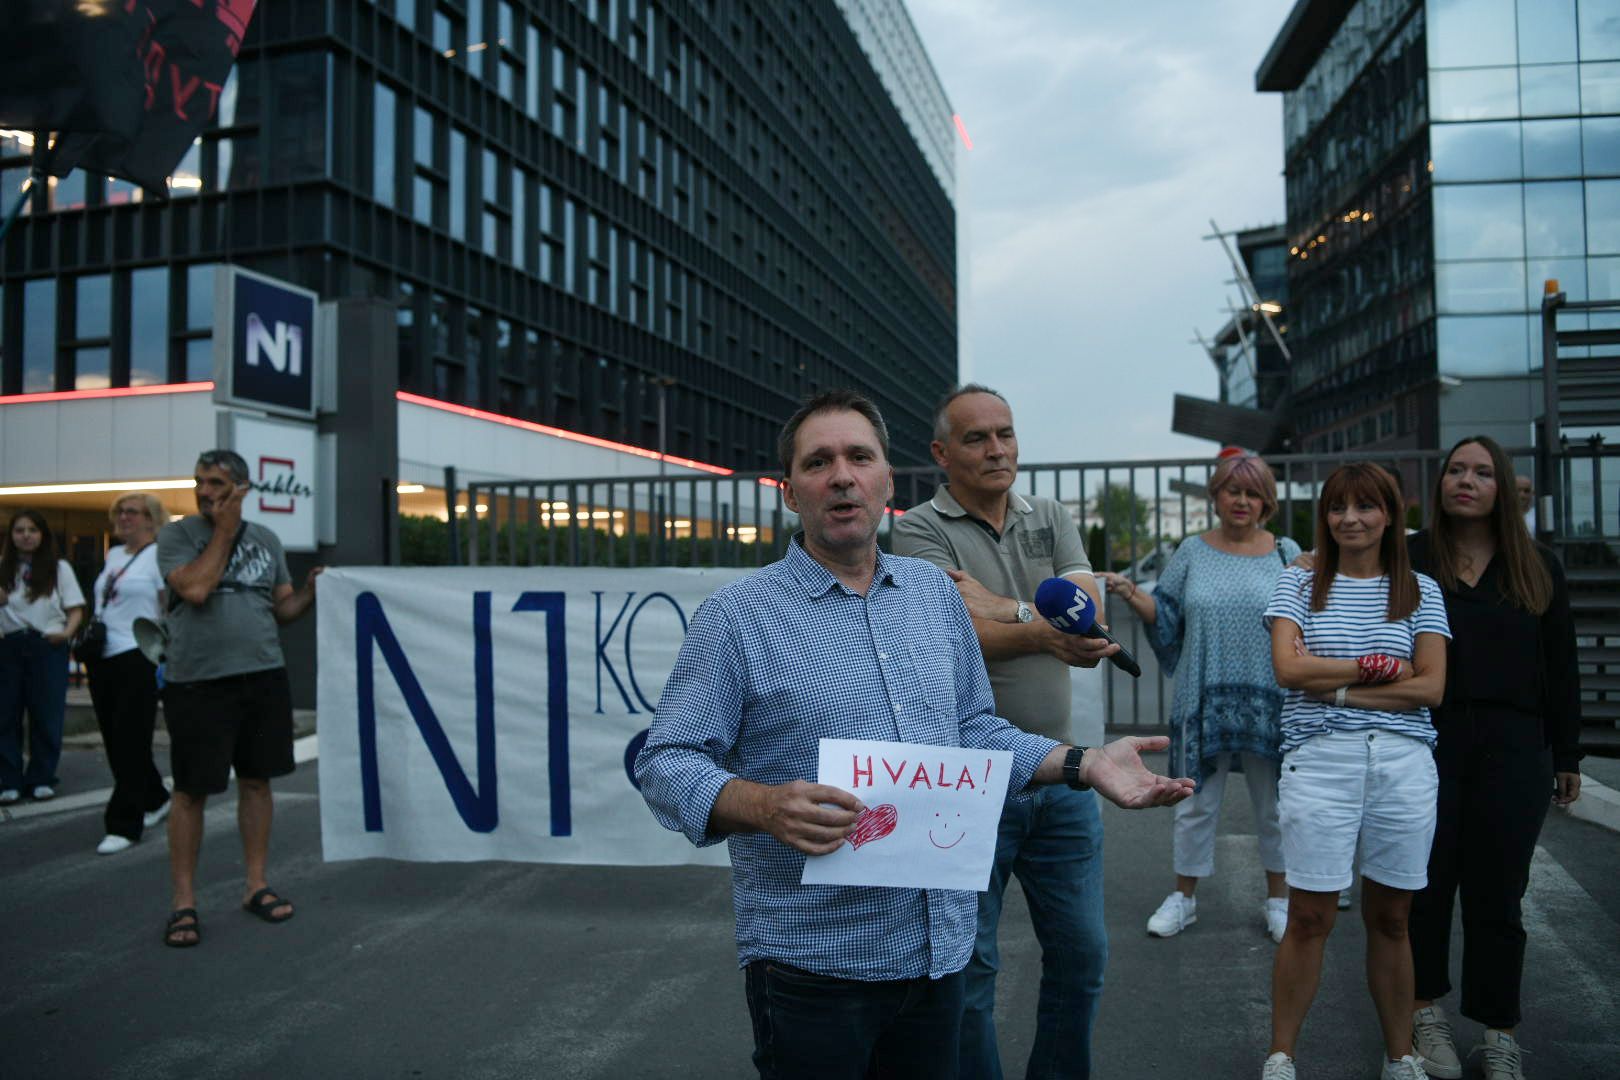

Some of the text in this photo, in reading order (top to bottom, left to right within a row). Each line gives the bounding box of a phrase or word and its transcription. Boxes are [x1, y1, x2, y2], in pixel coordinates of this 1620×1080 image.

[246, 312, 303, 376] N1
[1067, 589, 1088, 621] N1
[356, 591, 572, 837] N1
[852, 753, 993, 796] HVALA!
